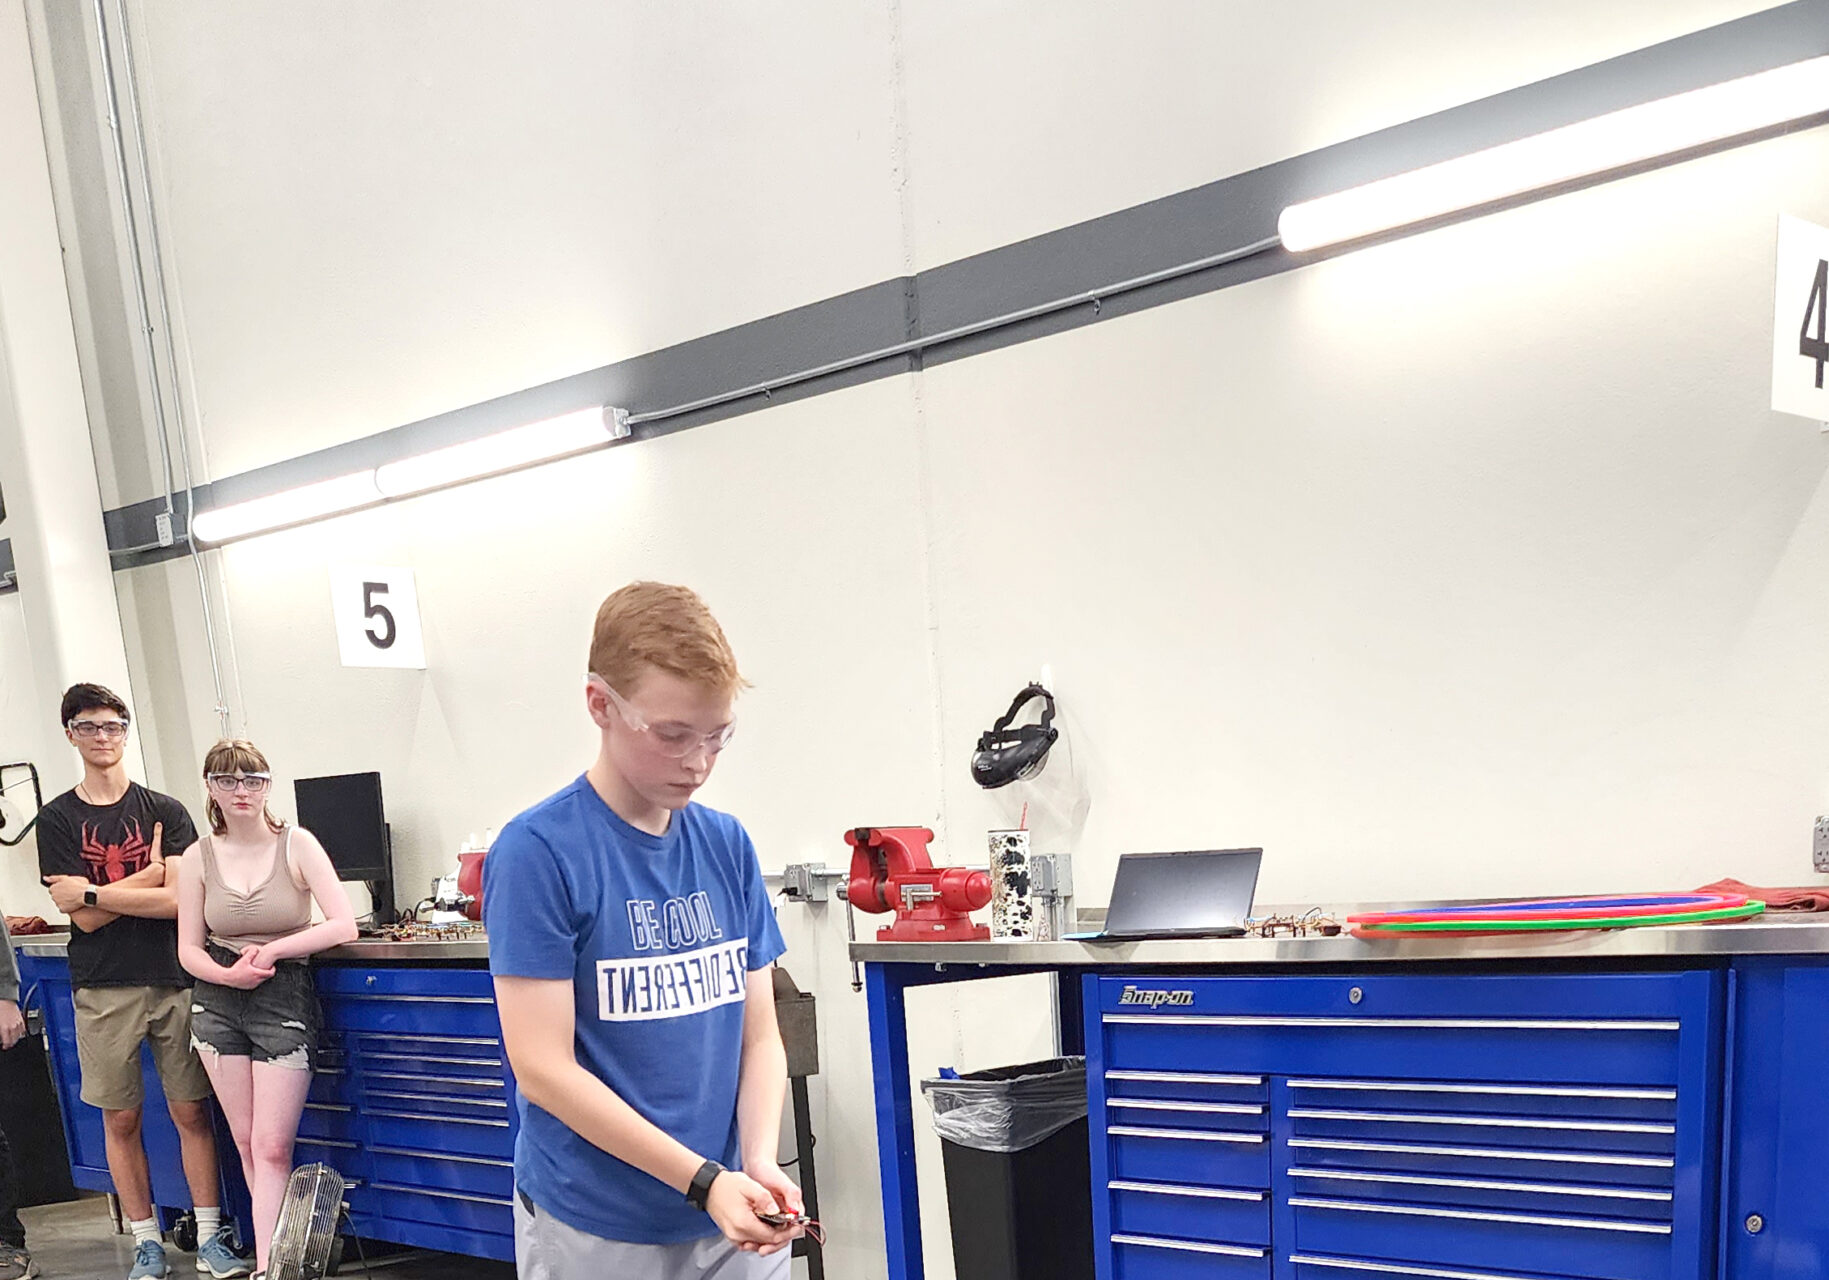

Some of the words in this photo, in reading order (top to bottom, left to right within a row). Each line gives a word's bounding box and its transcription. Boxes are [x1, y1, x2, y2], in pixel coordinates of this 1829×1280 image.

[1799, 259, 1829, 389] 4
[362, 581, 396, 650] 5
[627, 900, 663, 950] BE
[663, 891, 722, 949] COOL
